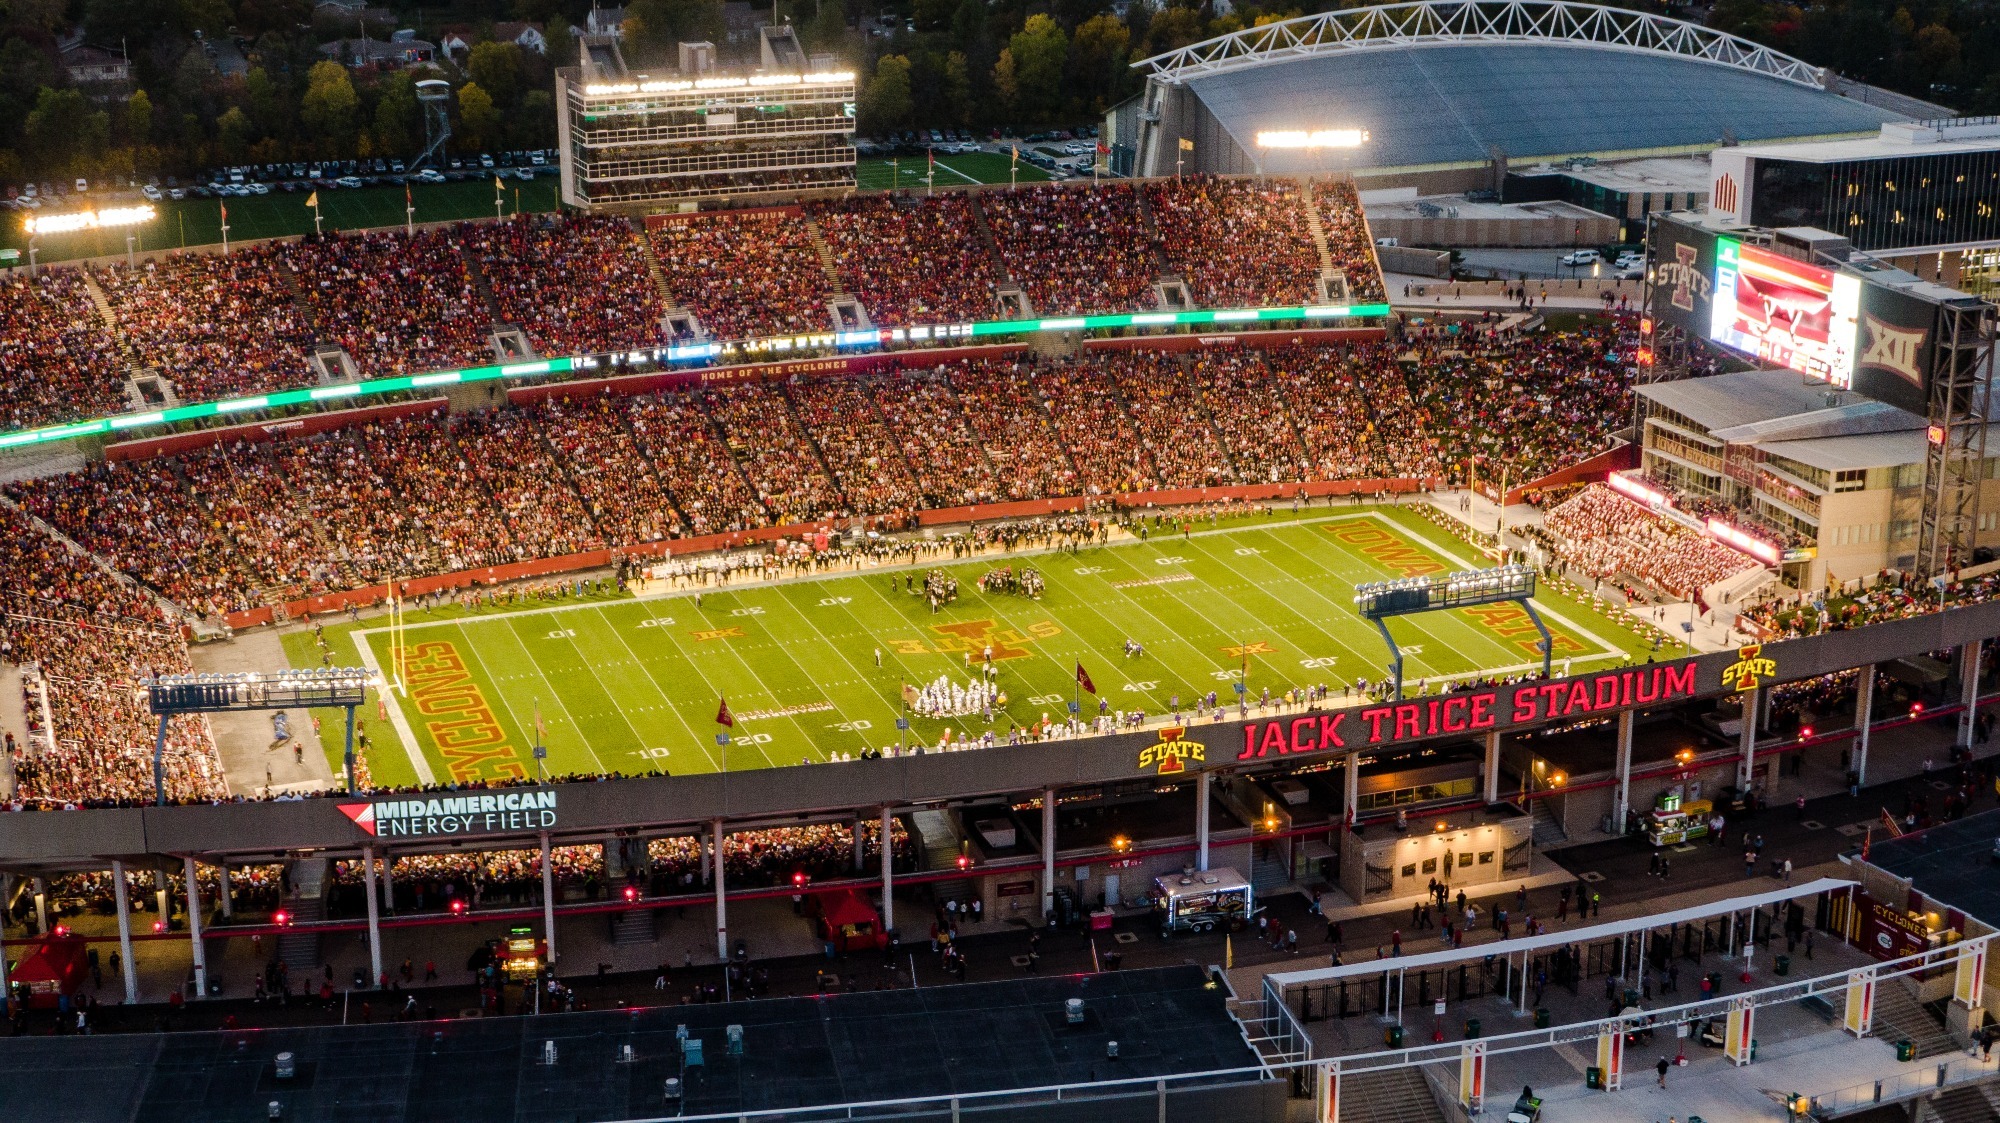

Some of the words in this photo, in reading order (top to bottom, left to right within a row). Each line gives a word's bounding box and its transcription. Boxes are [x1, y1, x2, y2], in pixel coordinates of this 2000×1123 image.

[662, 217, 690, 227] JACK
[1658, 263, 1710, 300] STATE
[701, 371, 733, 380] HOME
[739, 369, 752, 377] OF
[788, 360, 848, 373] CYCLONES
[1656, 436, 1684, 458] IOWA
[1685, 449, 1723, 472] STATE
[1764, 483, 1822, 521] CYCLONES
[1154, 556, 1186, 565] 20
[1320, 520, 1448, 578] IOWA
[550, 628, 576, 639] 10
[641, 617, 676, 628] 20
[888, 620, 1063, 654] STATE
[1210, 669, 1246, 680] 30
[1299, 657, 1332, 669] 20
[1722, 657, 1776, 686] STATE
[1122, 681, 1154, 692] 40
[1027, 693, 1064, 705] 50
[388, 641, 530, 786] CYCLONES
[1237, 712, 1346, 761] JACK
[1362, 693, 1496, 743] TRICE
[1512, 662, 1697, 723] STADIUM
[834, 719, 872, 732] 30
[733, 732, 773, 746] 20
[640, 747, 670, 760] 10
[1139, 740, 1205, 769] STATE
[375, 791, 557, 819] MIDAMERICAN
[376, 814, 474, 837] ENERGY
[486, 810, 557, 831] FIELD
[1875, 906, 1928, 938] CYCLONES
